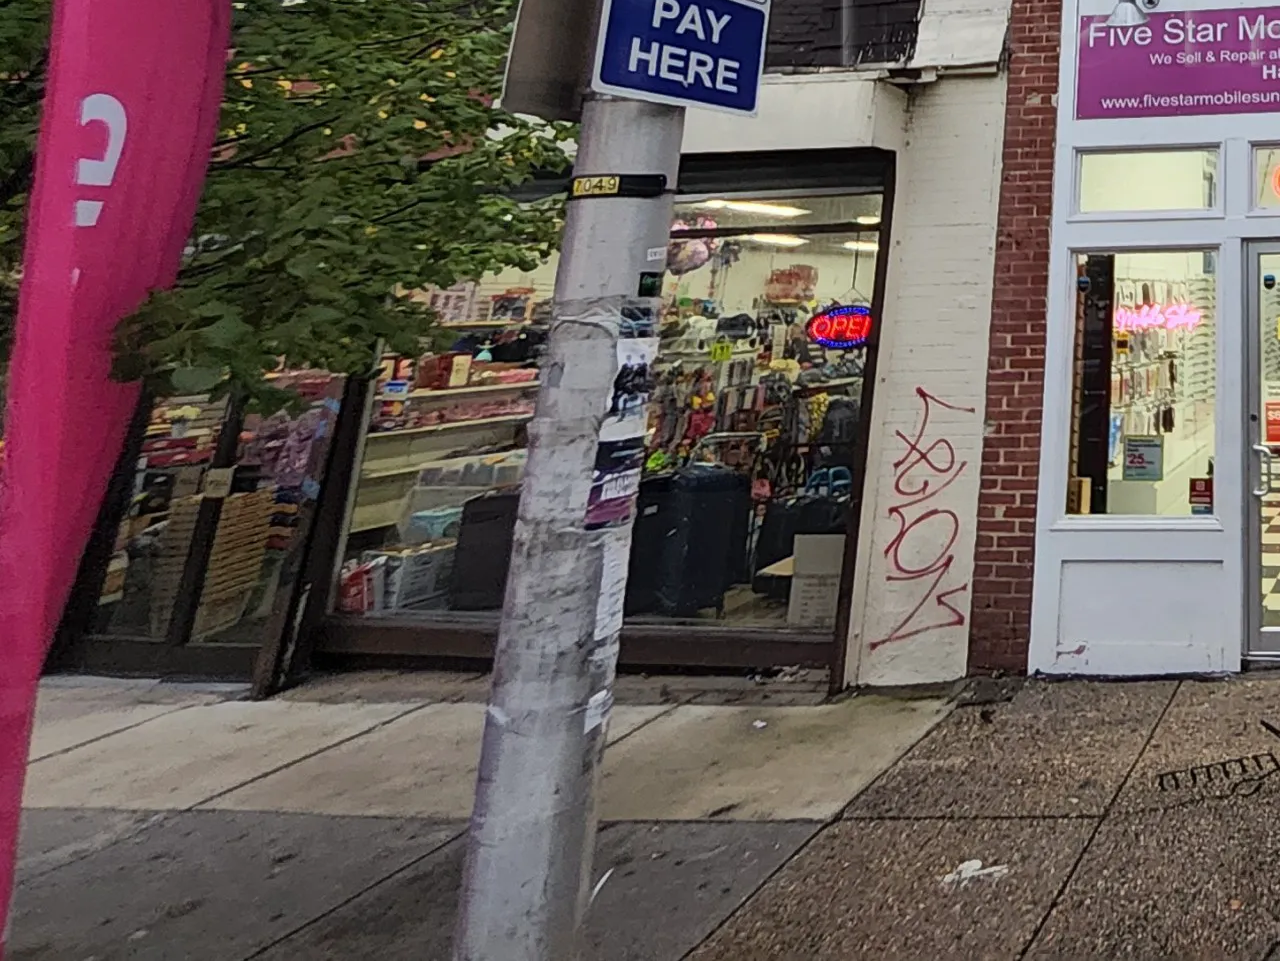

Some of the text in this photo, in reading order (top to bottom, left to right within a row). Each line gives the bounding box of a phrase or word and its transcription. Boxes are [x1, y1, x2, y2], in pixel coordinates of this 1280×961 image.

[1088, 22, 1152, 48] Five
[1163, 17, 1228, 45] Star
[628, 37, 740, 93] HERE
[1150, 52, 1172, 65] We
[1176, 50, 1201, 64] Sell
[1205, 50, 1216, 62] &
[1220, 47, 1266, 64] Repair
